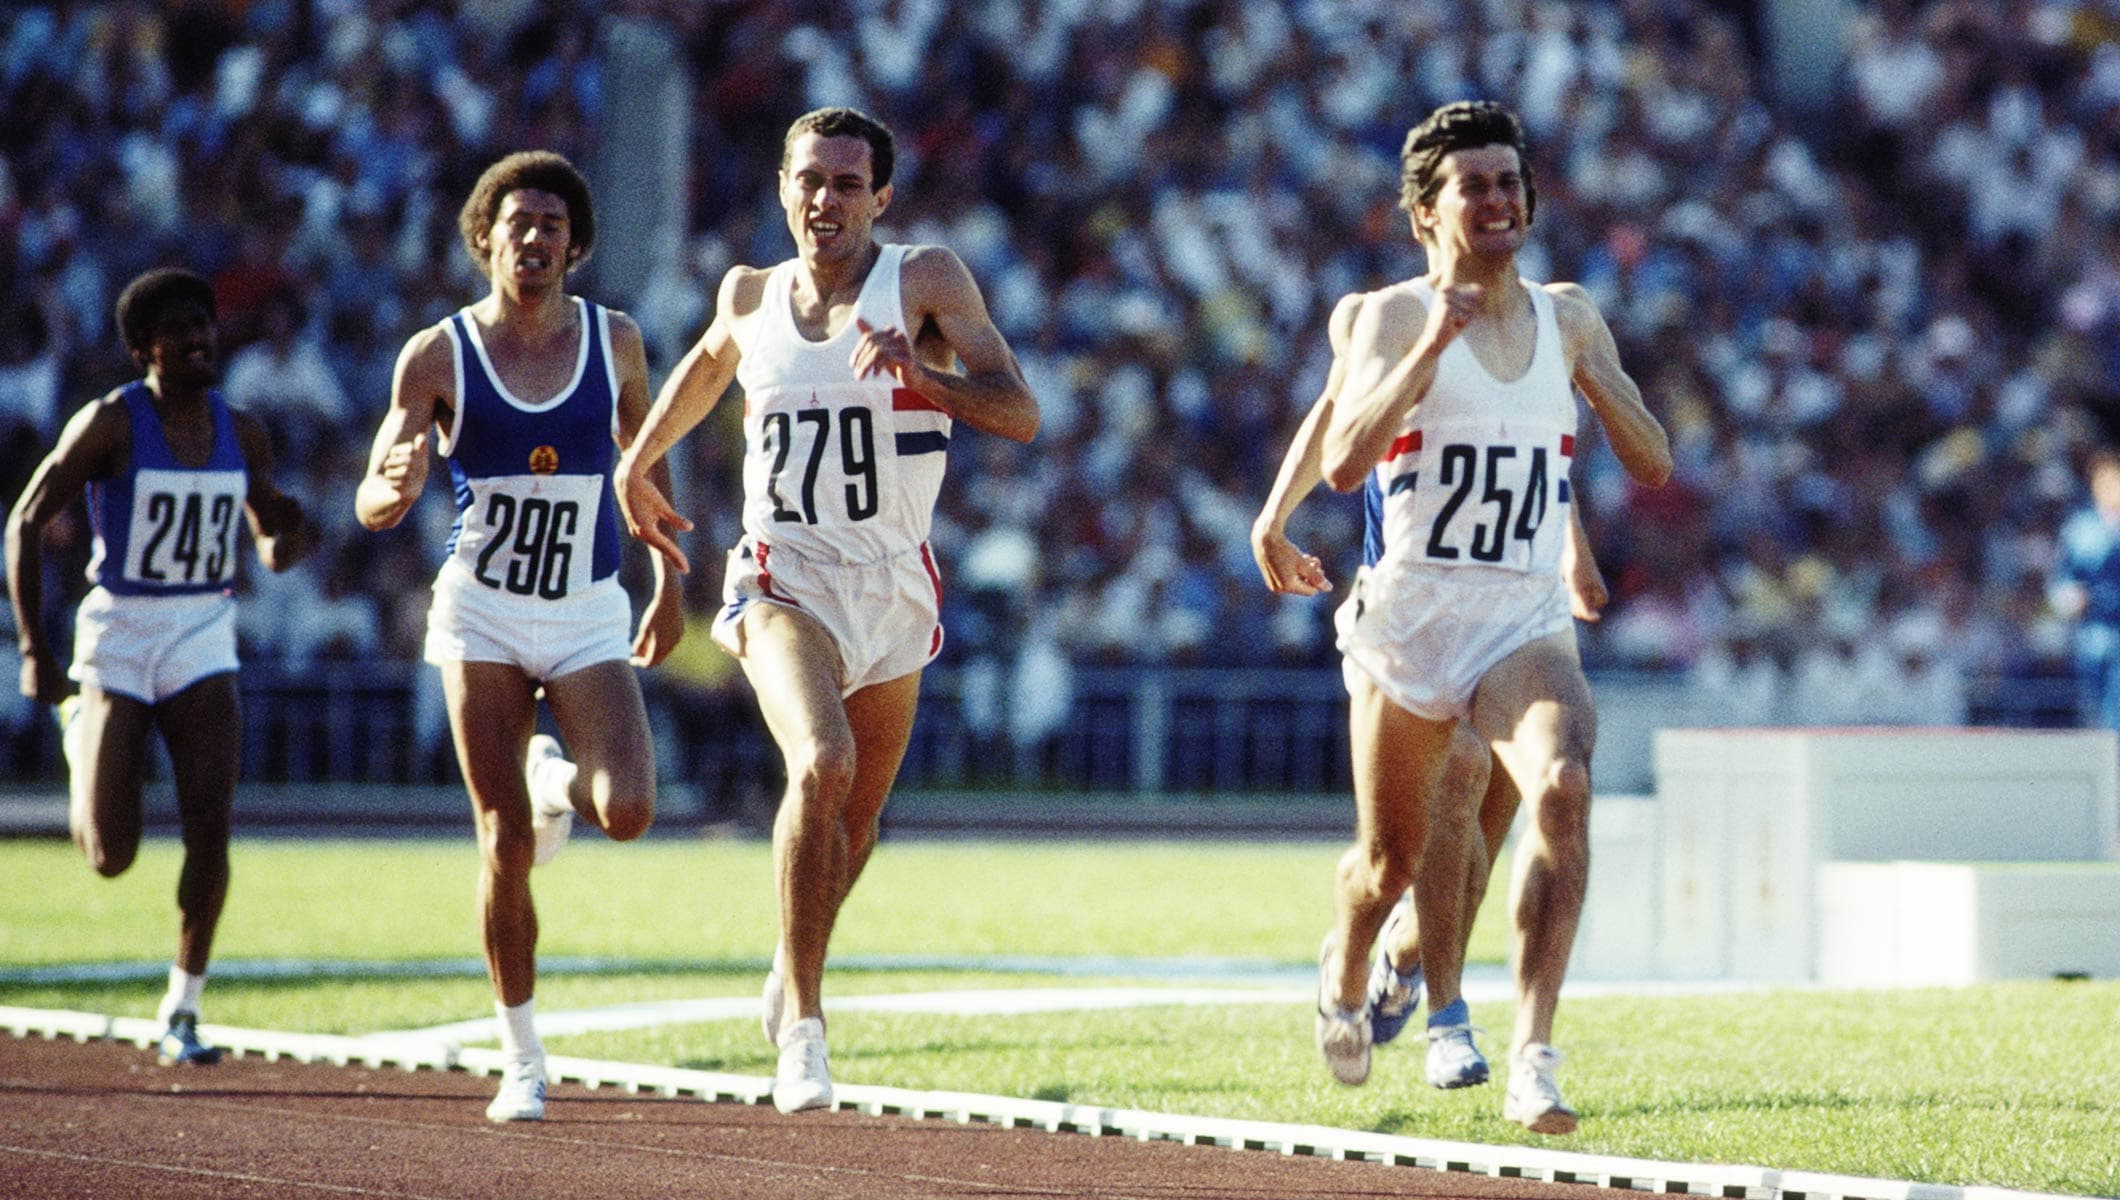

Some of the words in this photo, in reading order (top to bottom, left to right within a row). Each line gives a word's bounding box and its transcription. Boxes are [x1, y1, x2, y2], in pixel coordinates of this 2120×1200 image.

[763, 407, 878, 525] 279
[1426, 444, 1547, 562] 254
[140, 492, 234, 580] 243
[475, 493, 579, 600] 296
